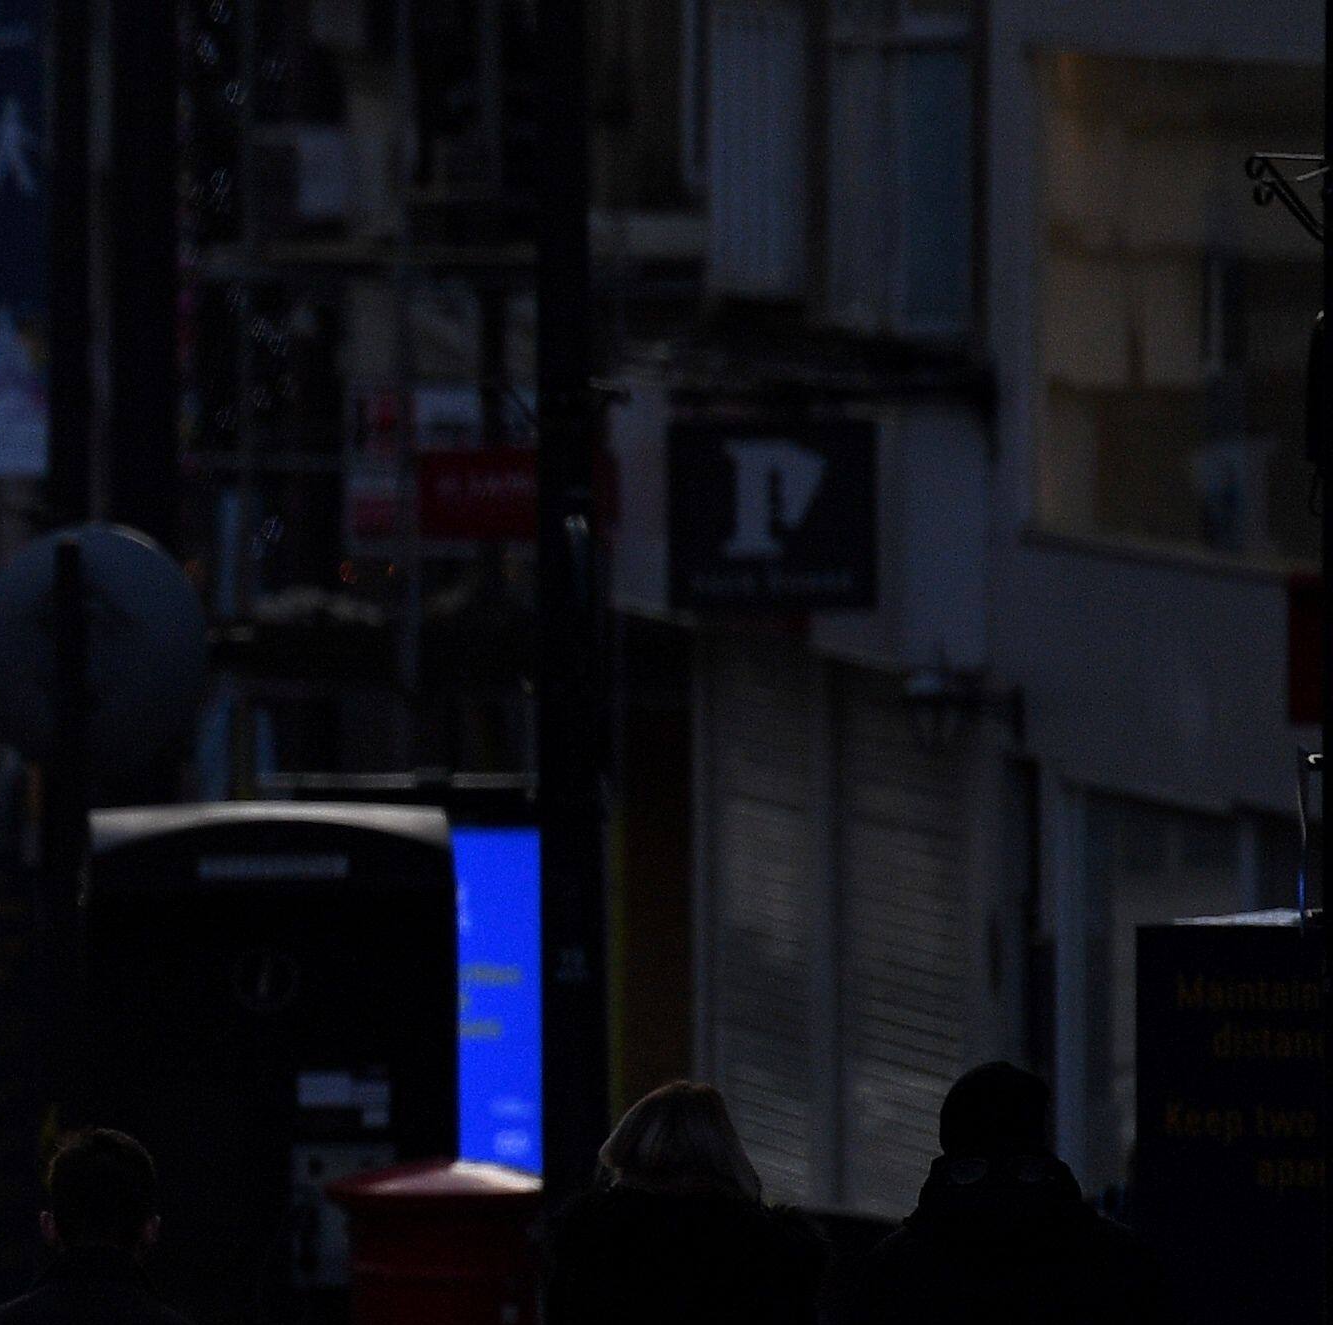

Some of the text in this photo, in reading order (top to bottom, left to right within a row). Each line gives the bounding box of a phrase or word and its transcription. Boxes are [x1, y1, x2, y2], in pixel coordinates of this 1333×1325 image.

[1175, 972, 1321, 1010] Maintain
[1164, 1100, 1317, 1146] Keep two
